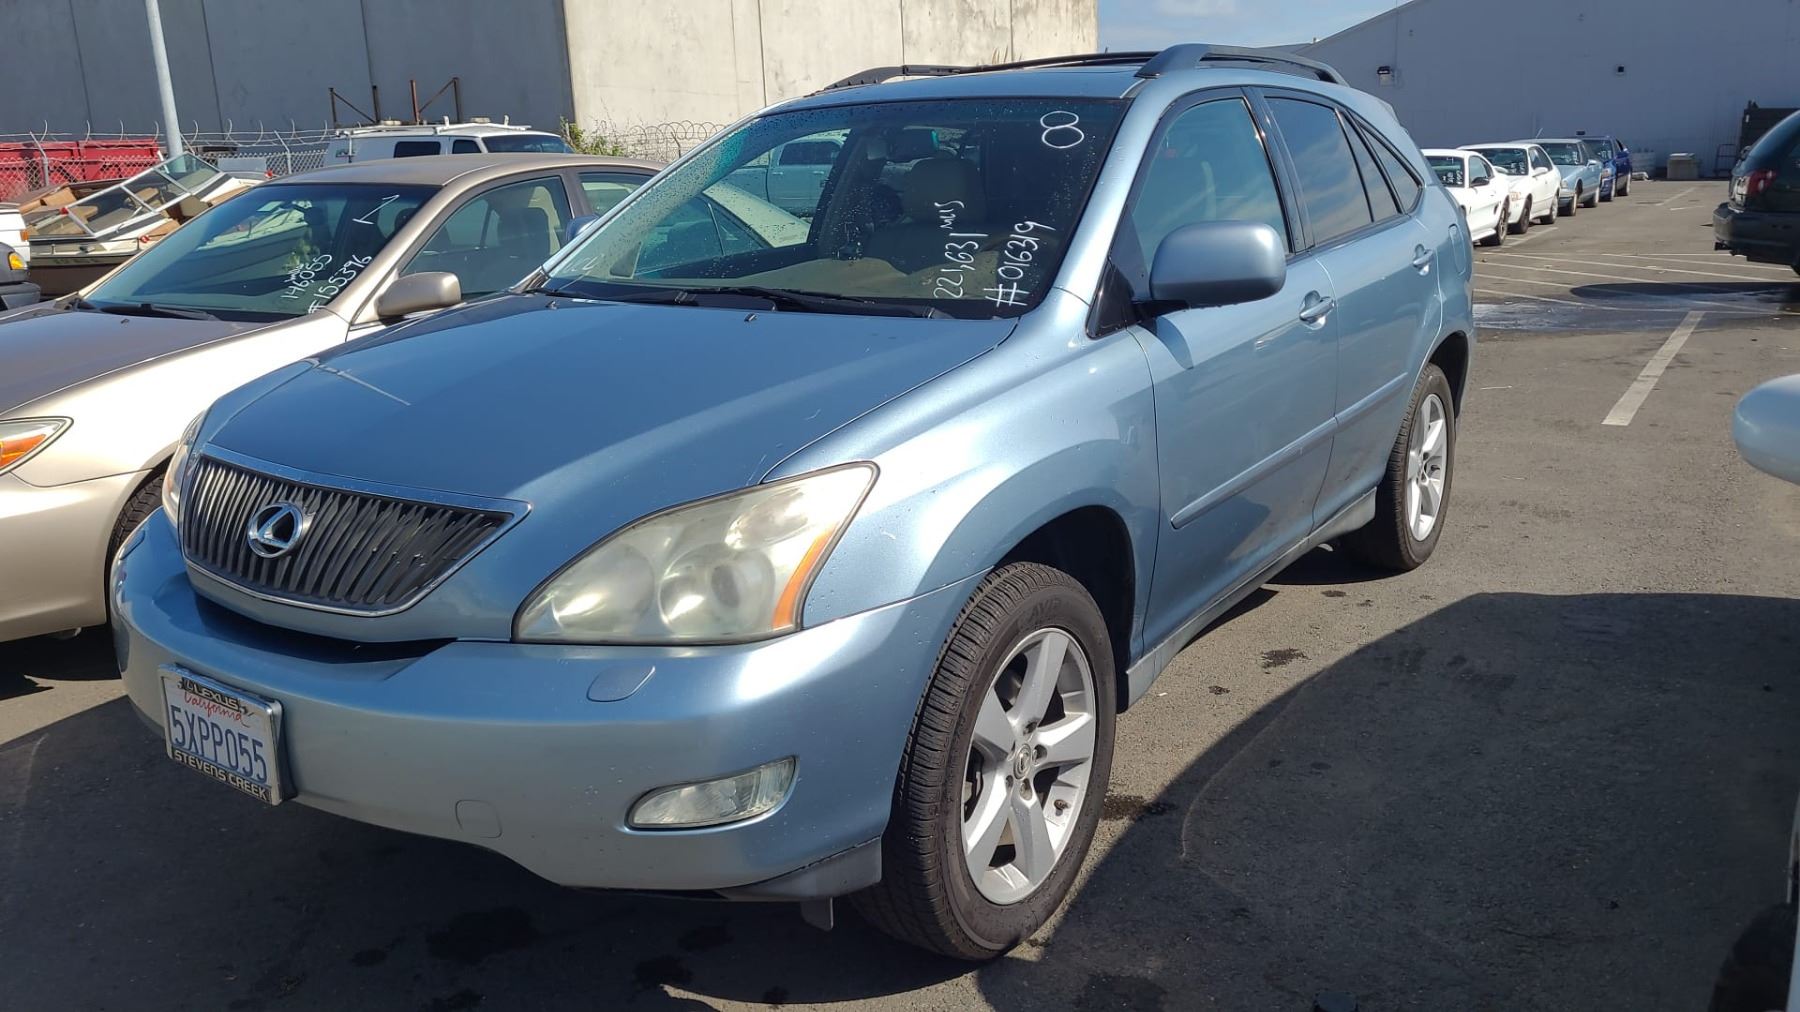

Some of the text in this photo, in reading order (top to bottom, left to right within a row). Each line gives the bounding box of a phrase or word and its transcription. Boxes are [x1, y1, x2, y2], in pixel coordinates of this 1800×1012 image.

[1040, 111, 1084, 148] 8
[983, 221, 1056, 307] #016319
[193, 684, 238, 709] LEXUS
[170, 705, 267, 783] 5XPP055
[174, 750, 267, 800] STEVENS CREEK
